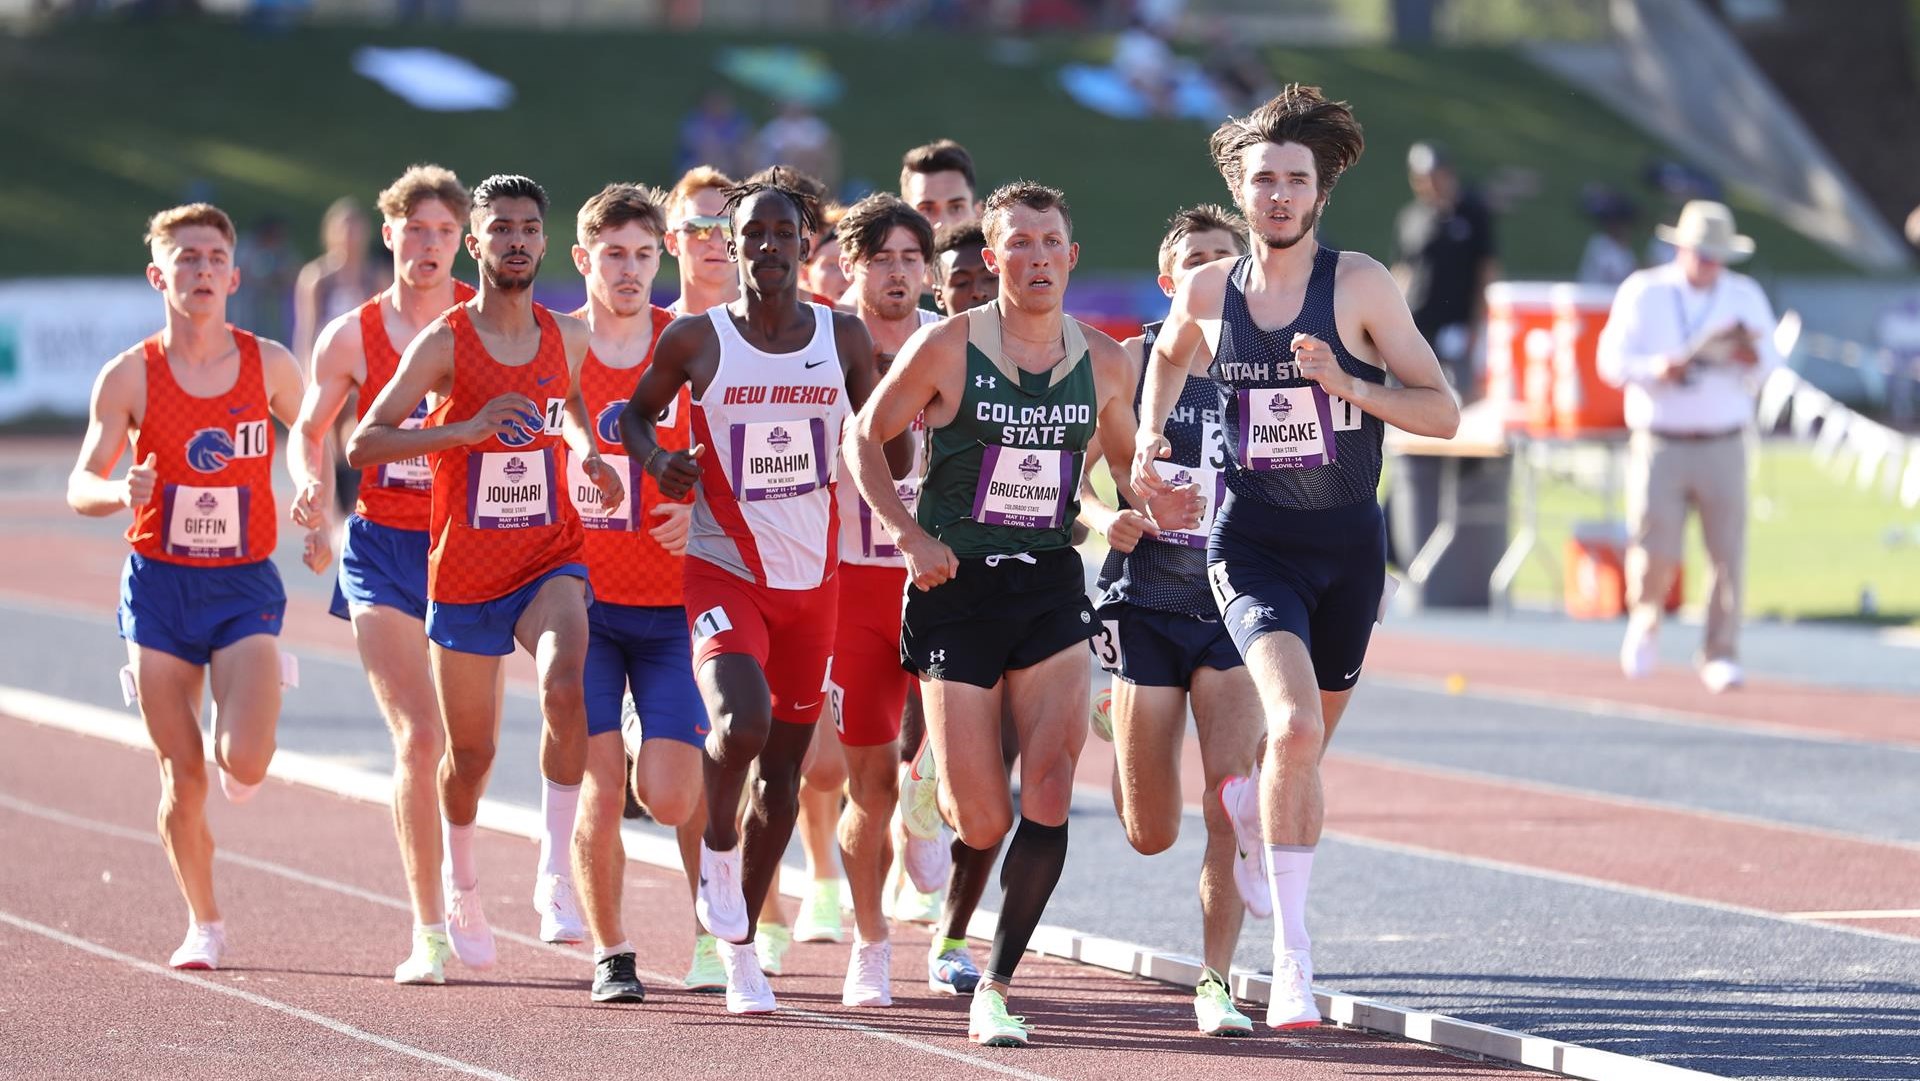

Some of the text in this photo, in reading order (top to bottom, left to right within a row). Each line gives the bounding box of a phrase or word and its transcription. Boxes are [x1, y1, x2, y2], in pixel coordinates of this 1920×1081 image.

[1221, 362, 1269, 381] UTAH
[723, 385, 839, 406] NEW MEXICO
[976, 401, 1090, 425] COLORADO
[240, 424, 265, 456] 10
[1001, 426, 1066, 445] STATE
[1253, 422, 1318, 443] PANCAKE
[1209, 429, 1226, 470] 3
[750, 453, 809, 474] IBRAHIM
[486, 484, 541, 503] JOUHARI
[989, 481, 1059, 501] BRUECKMAN
[184, 518, 227, 535] GIFFIN
[1098, 626, 1117, 664] 3
